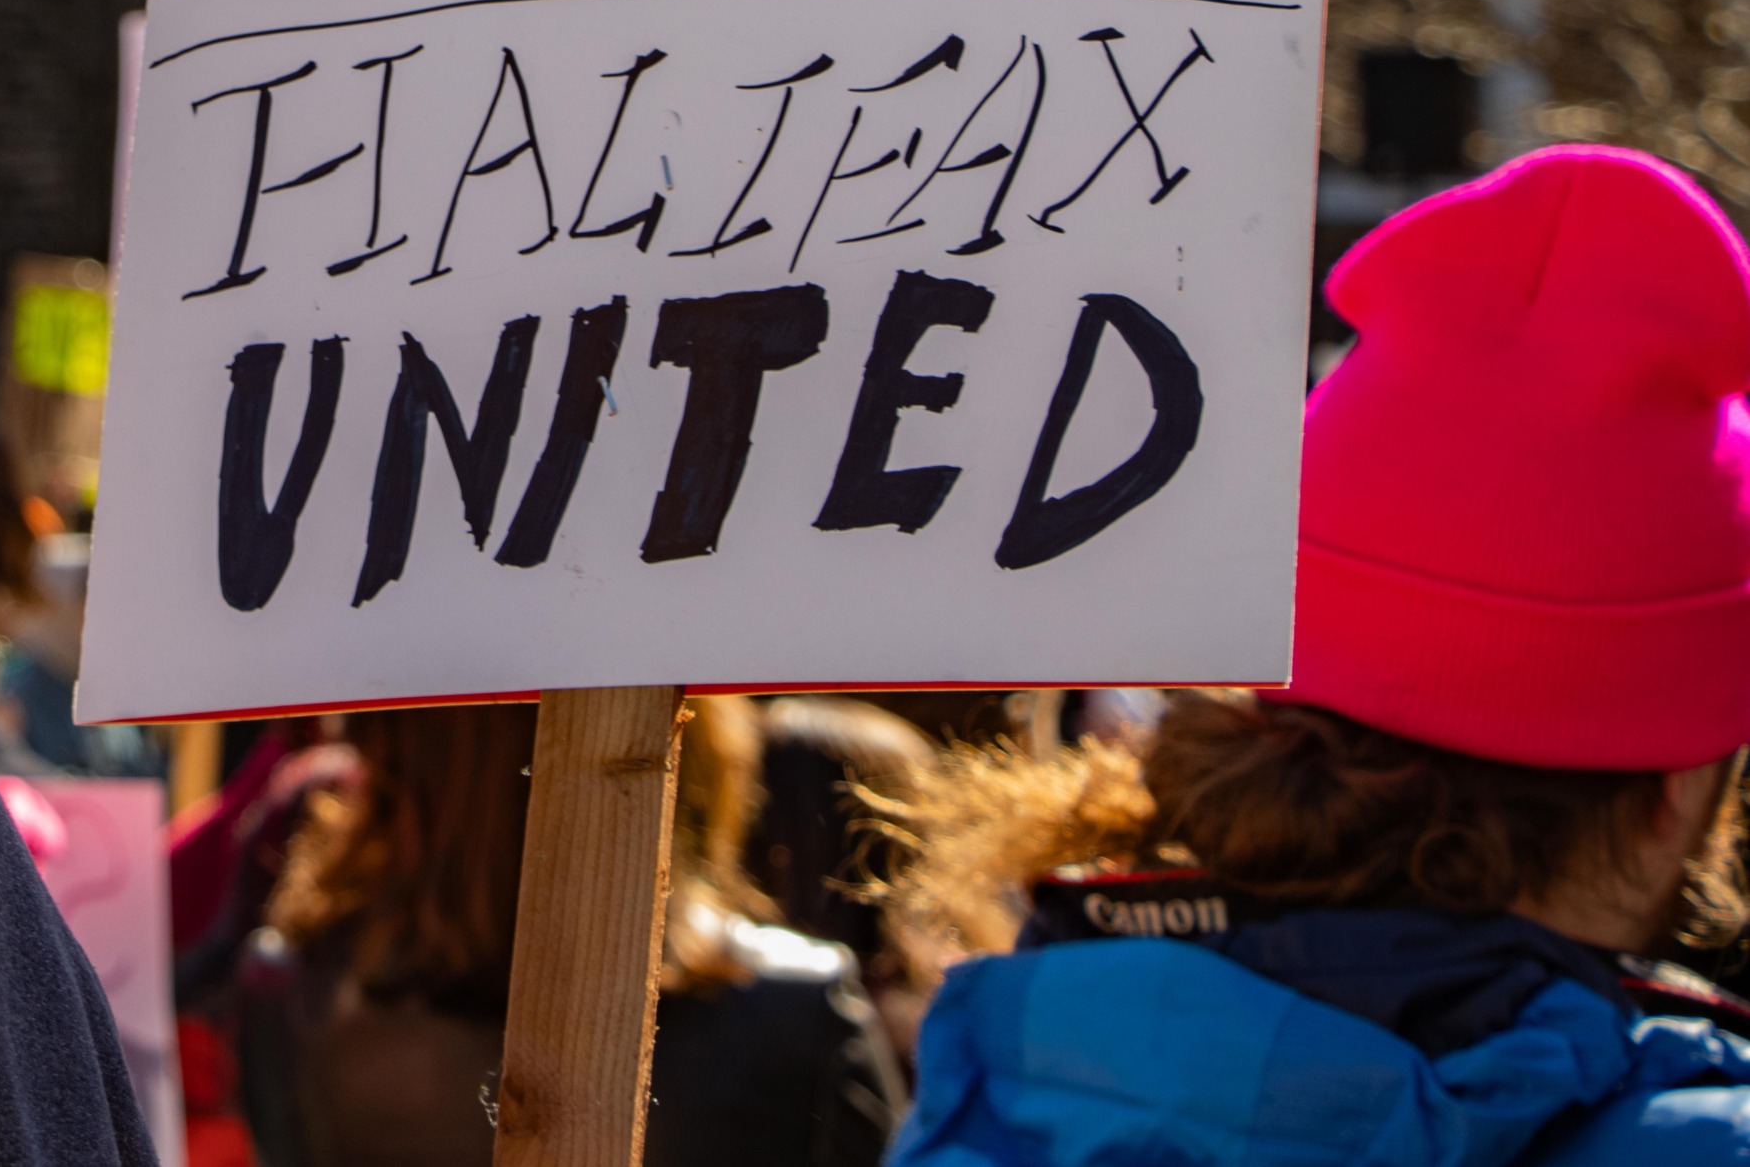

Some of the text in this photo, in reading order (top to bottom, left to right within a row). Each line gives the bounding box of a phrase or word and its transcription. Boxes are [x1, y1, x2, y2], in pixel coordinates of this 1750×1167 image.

[180, 24, 1215, 301] HALIFAX
[216, 268, 1205, 612] UNITED
[1083, 893, 1228, 937] Canon
